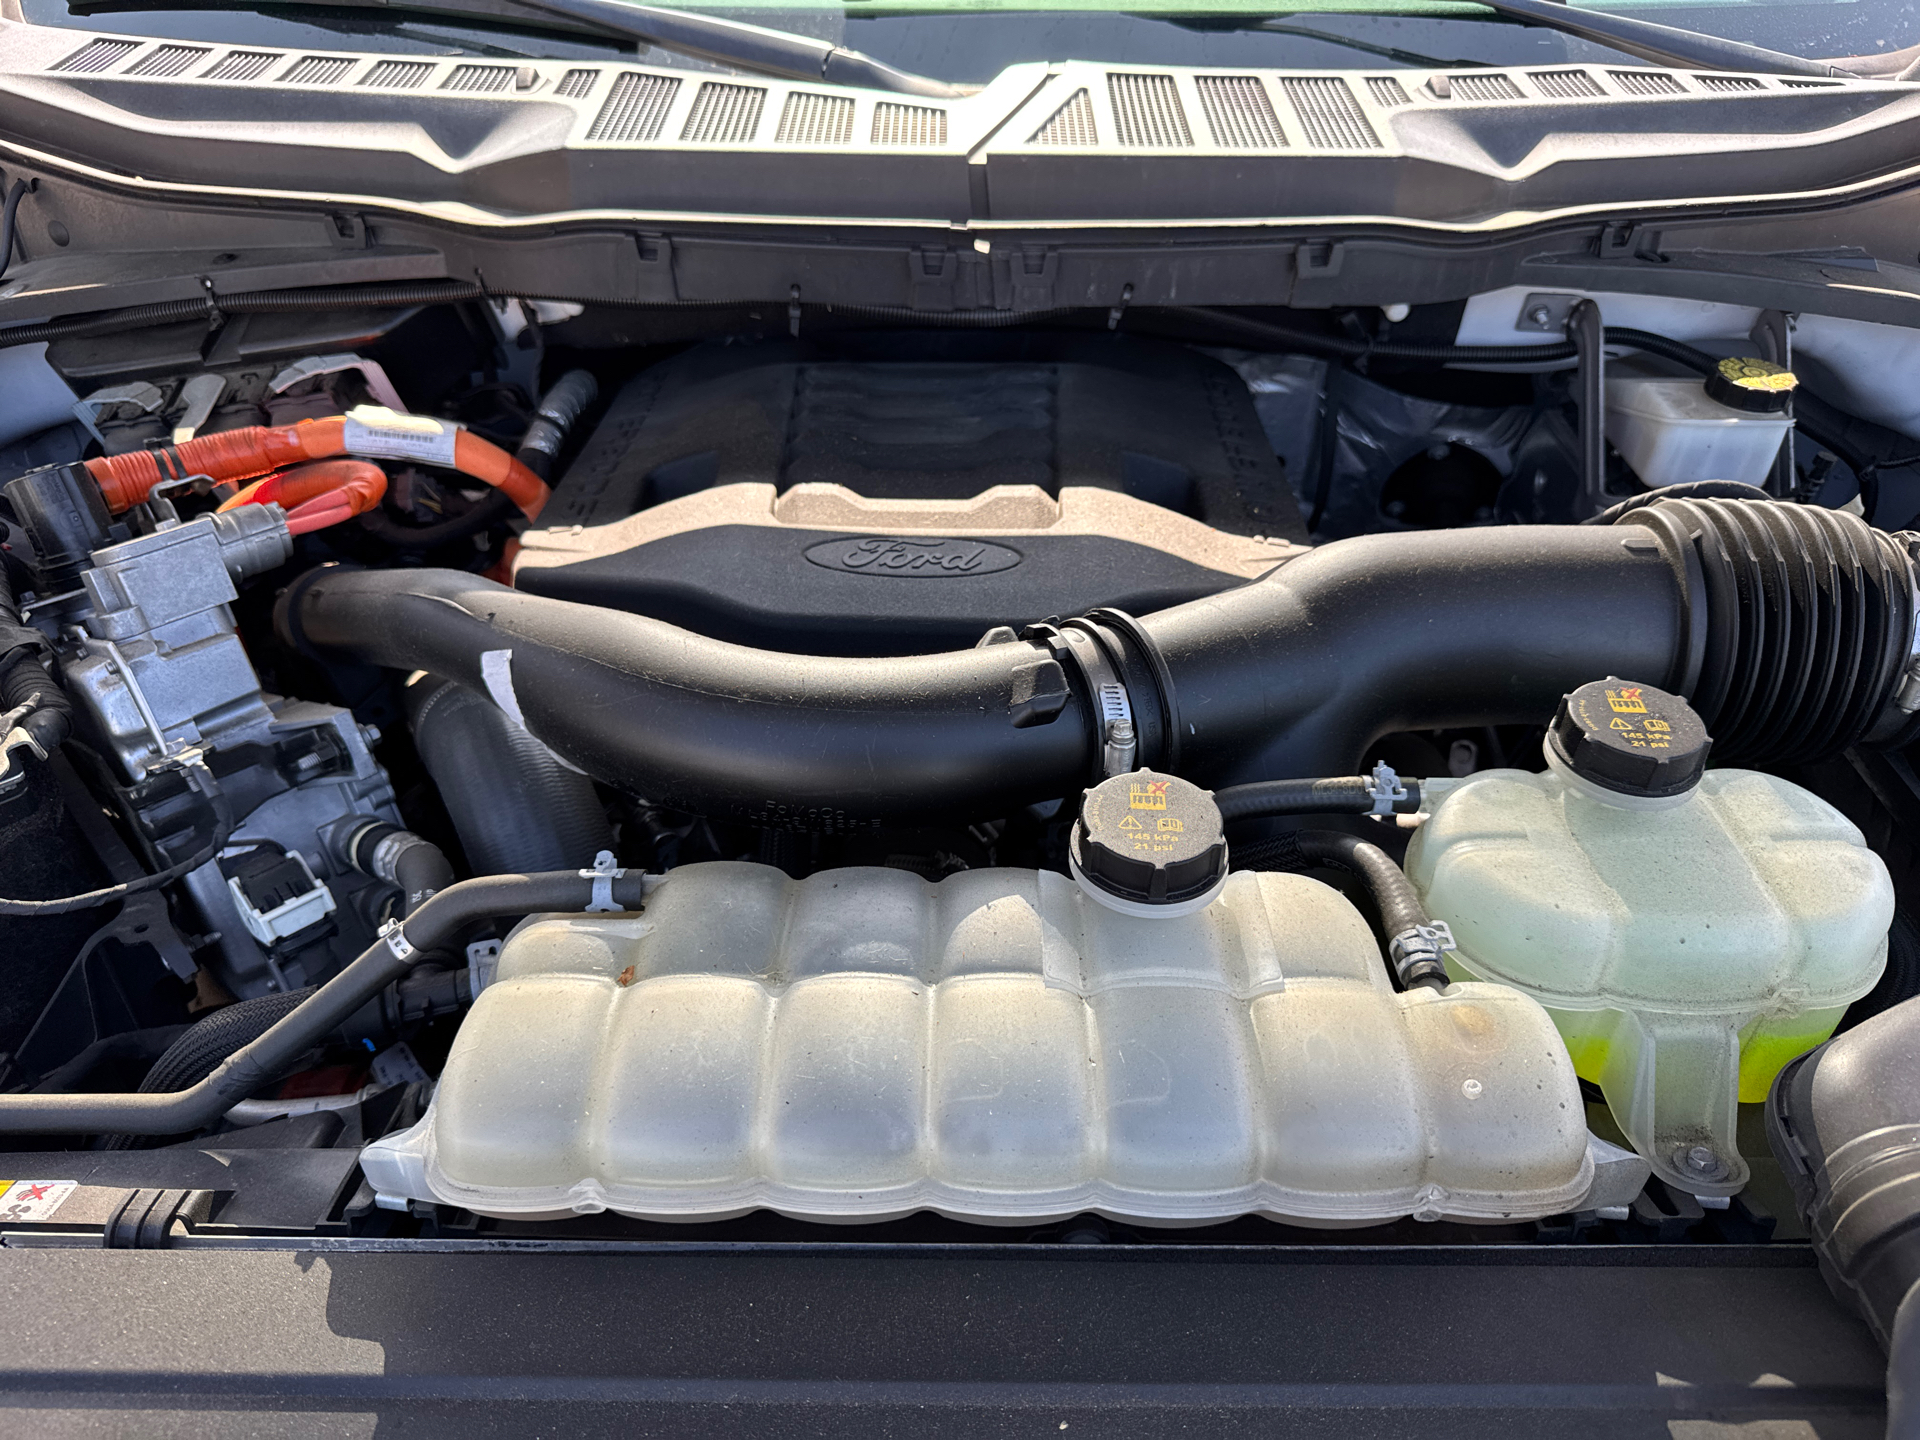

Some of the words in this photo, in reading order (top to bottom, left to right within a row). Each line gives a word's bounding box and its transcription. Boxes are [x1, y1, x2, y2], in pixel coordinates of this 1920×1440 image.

[842, 539, 985, 571] Ford
[1647, 732, 1672, 740] kPa
[1650, 741, 1669, 749] psi
[1154, 834, 1179, 842] kPa
[1134, 842, 1149, 850] 21
[1153, 843, 1173, 851] psi
